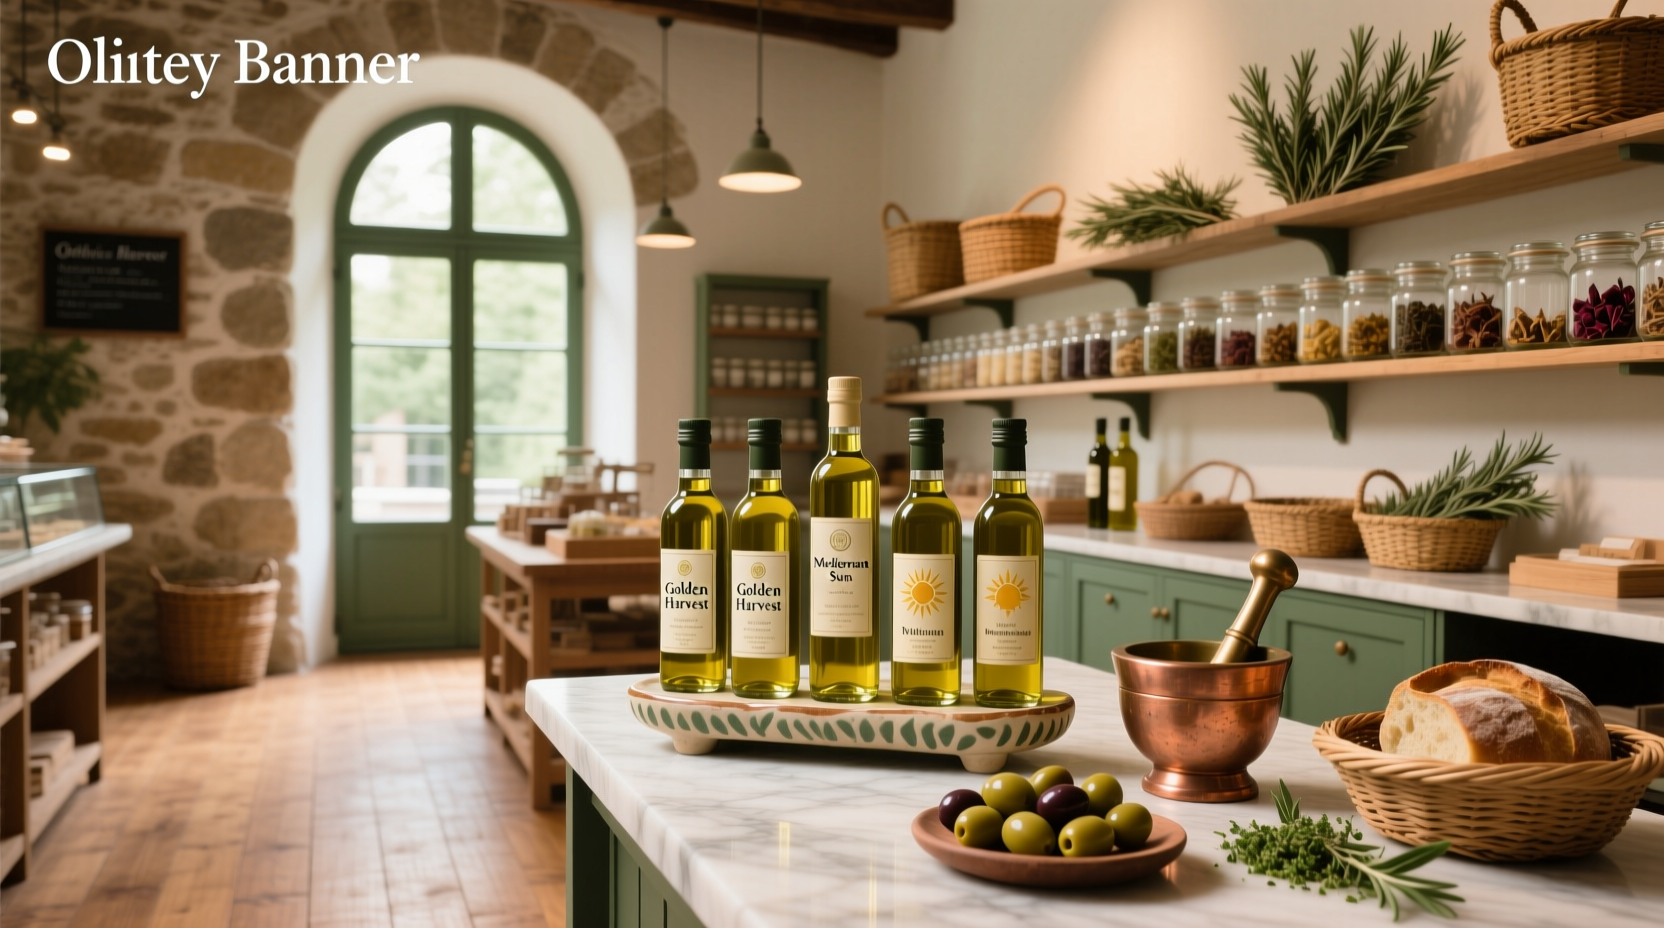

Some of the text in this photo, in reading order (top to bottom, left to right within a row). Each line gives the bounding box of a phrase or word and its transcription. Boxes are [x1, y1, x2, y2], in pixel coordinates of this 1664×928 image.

[665, 581, 708, 595] Golden
[736, 583, 781, 597] Golden
[665, 597, 708, 610] Harvest
[736, 598, 781, 611] Harvest
